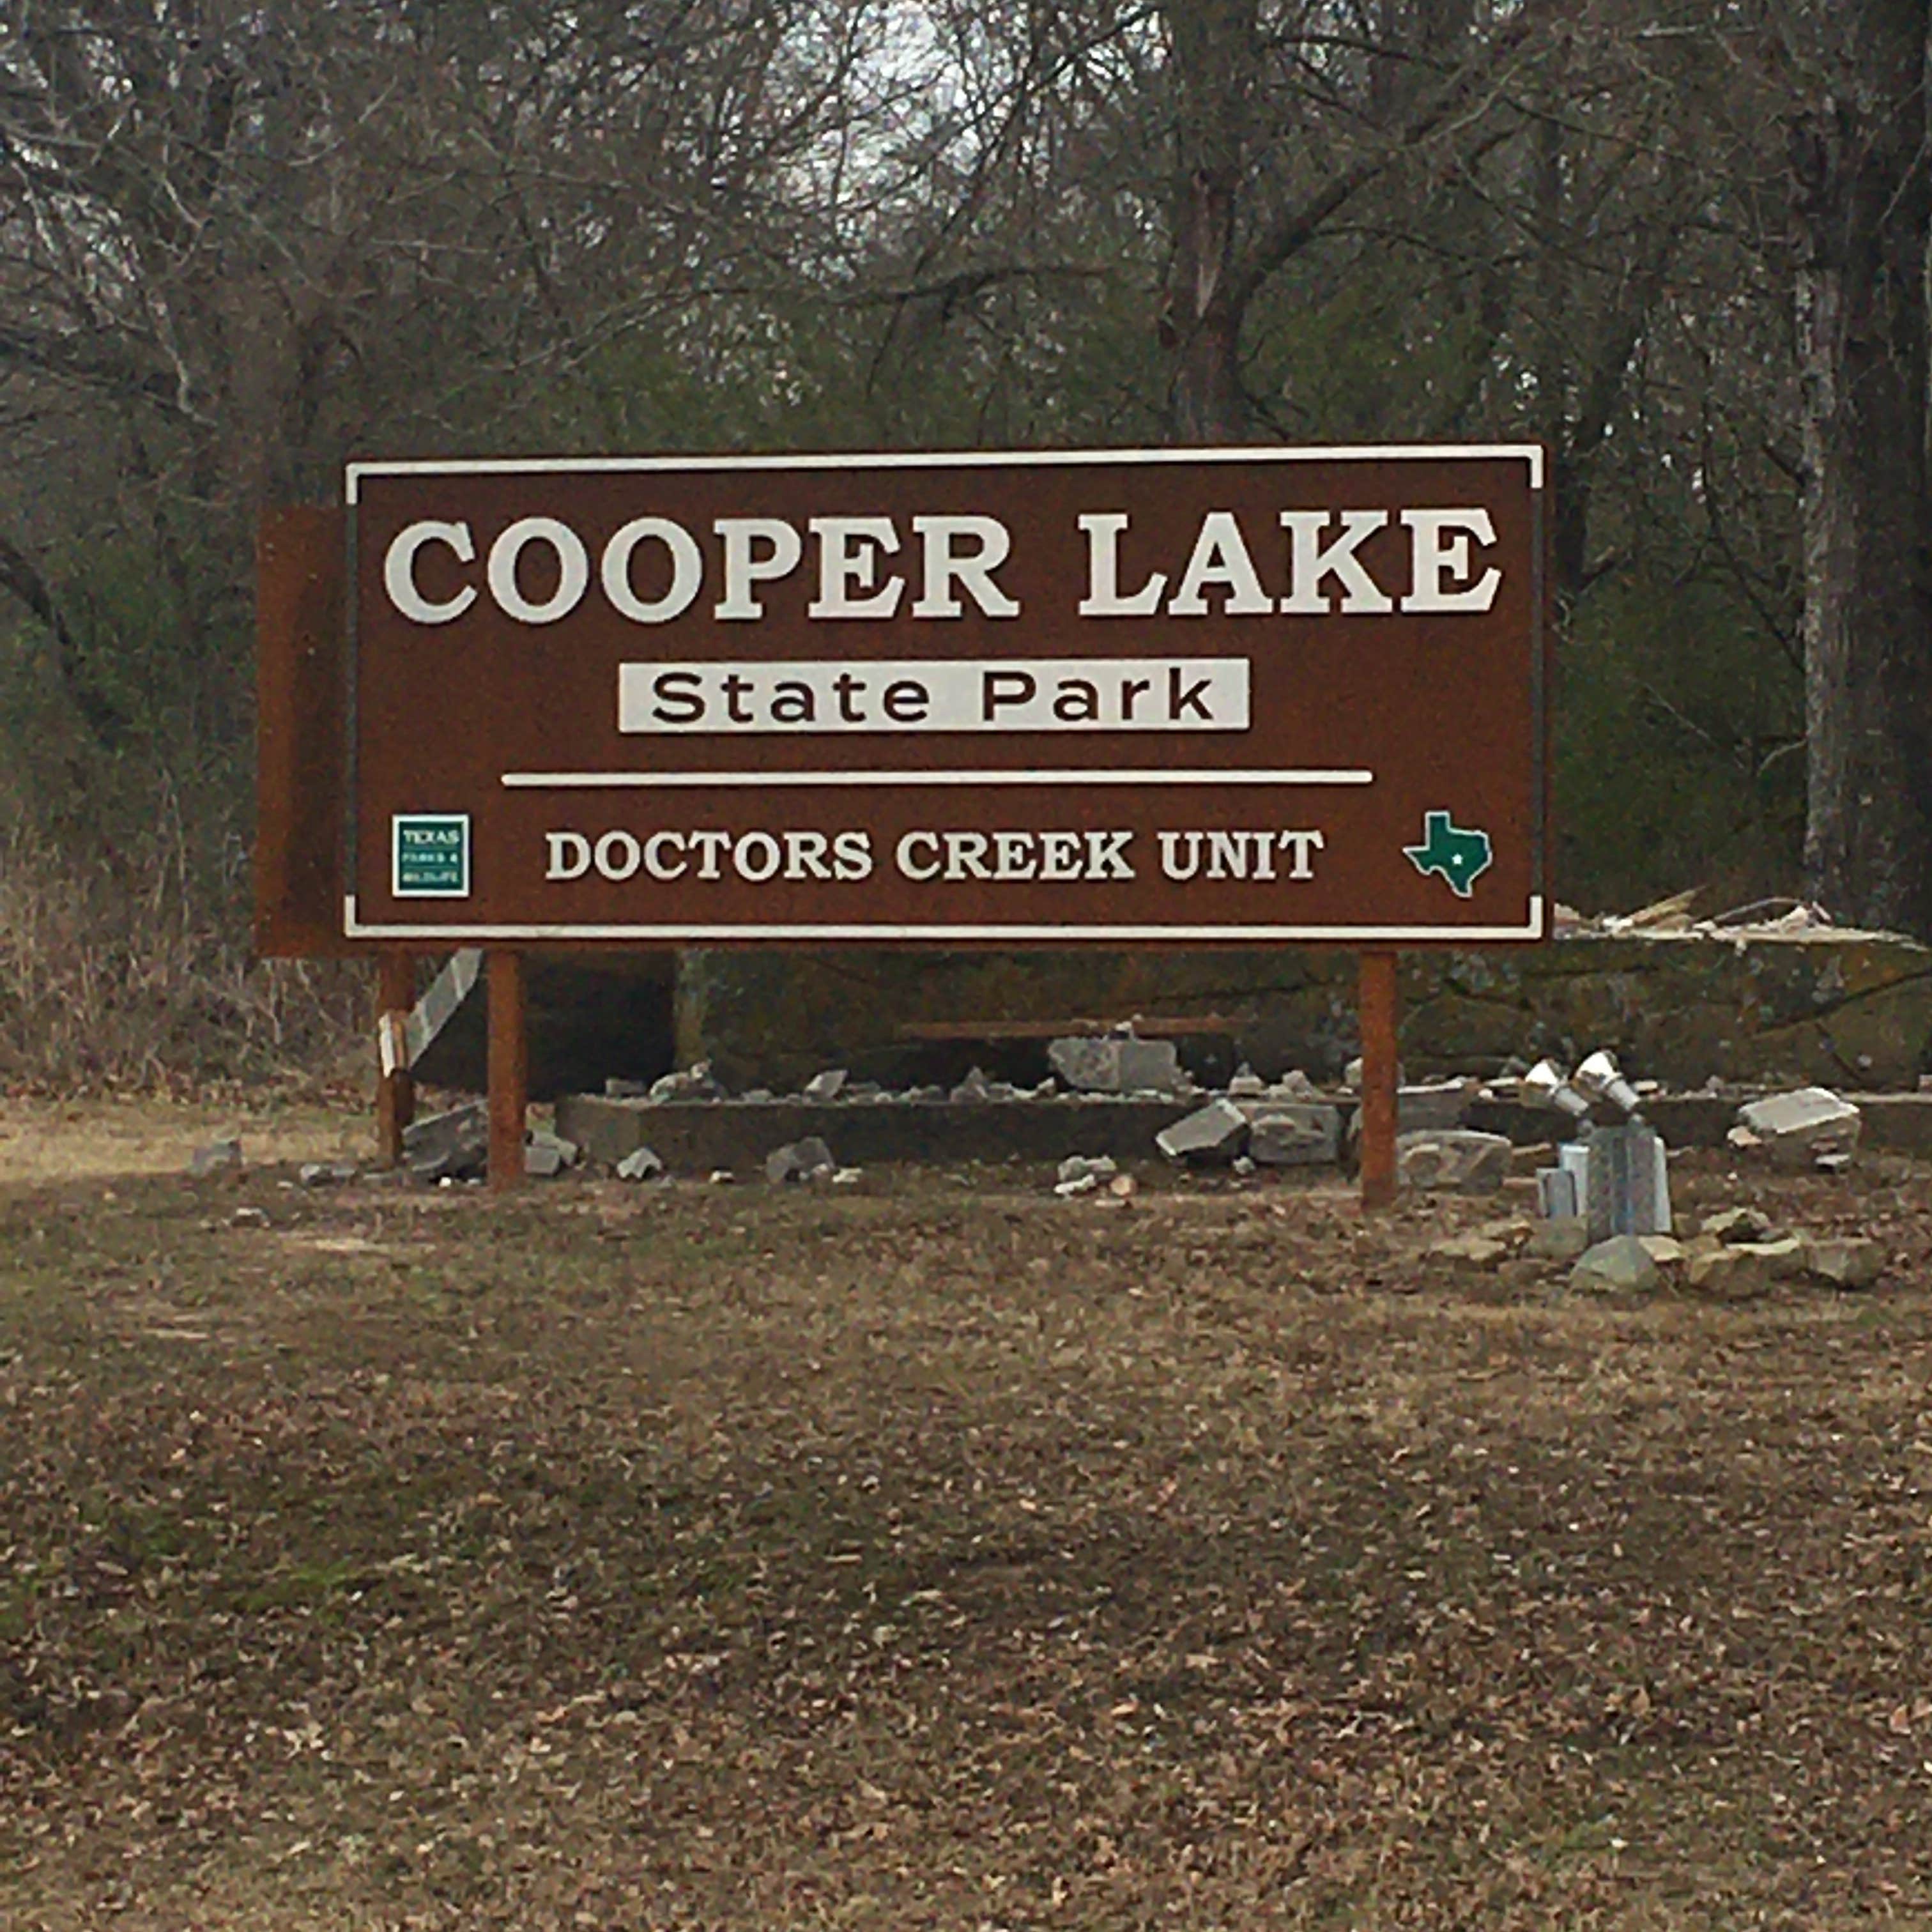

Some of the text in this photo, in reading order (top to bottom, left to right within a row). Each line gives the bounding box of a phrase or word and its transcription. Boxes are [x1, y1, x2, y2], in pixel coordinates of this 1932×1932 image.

[385, 508, 1501, 624] COOPER LAKE
[652, 667, 1214, 724] State Park
[402, 830, 459, 844] TEXAS
[545, 830, 1324, 880] DOCTORS CREEK UNIT
